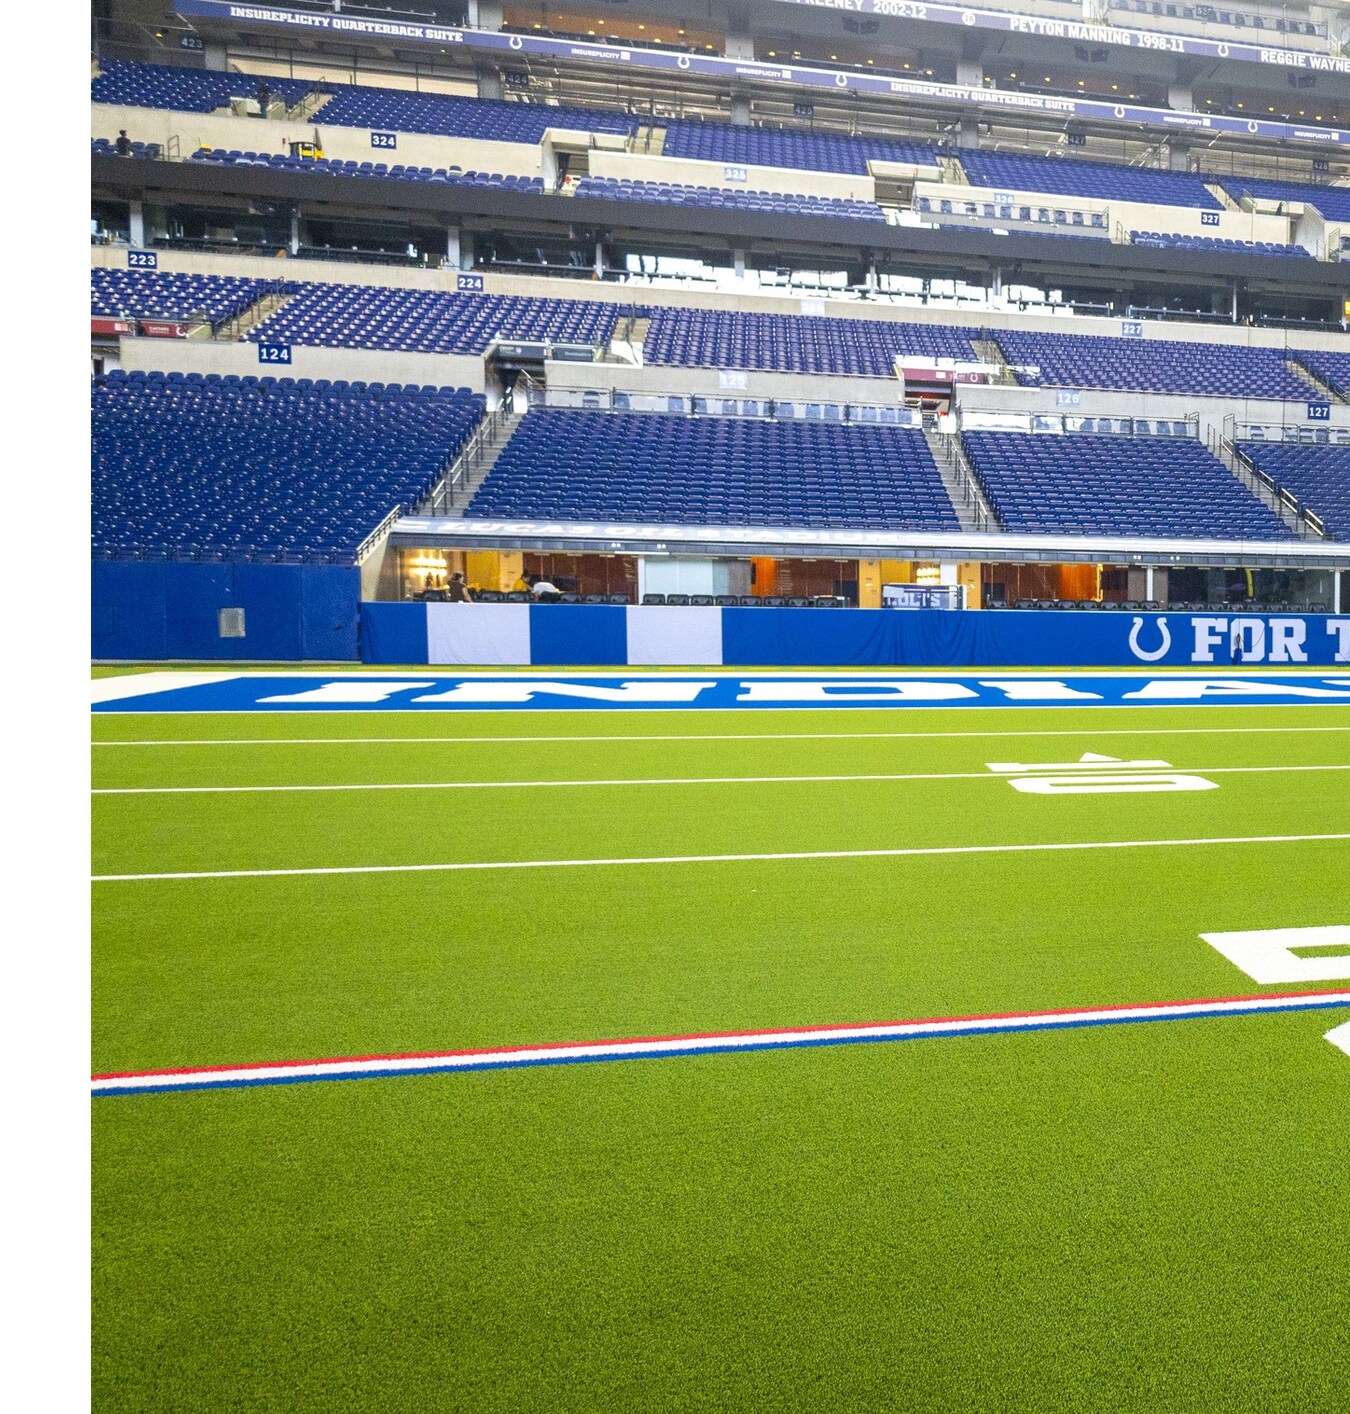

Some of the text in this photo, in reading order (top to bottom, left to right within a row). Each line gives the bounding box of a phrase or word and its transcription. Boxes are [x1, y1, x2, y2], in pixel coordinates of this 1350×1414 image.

[873, 1, 926, 18] 2002-12
[230, 6, 464, 42] INSUREPLICITY QUARTERBACK SUITE
[1010, 18, 1185, 53] PEYTON MANNING 1998-11
[571, 48, 620, 60] INSUREPLICITY
[1260, 50, 1306, 67] REGGIE
[736, 67, 782, 78] INSUREPLICITY
[890, 82, 1075, 111] INSUREPLICITY QUARTERBACK SUITE
[372, 135, 395, 147] 324
[725, 169, 747, 181] 325
[995, 194, 1014, 206] 326
[1202, 213, 1220, 225] 327
[129, 254, 155, 267] 223
[459, 278, 482, 290] 224
[1123, 324, 1143, 335] 227
[260, 348, 289, 362] 124
[1056, 392, 1079, 405] 126
[1308, 405, 1328, 418] 127
[438, 521, 899, 543] LUCAS OIL STADIUM
[1191, 618, 1308, 662] FOR
